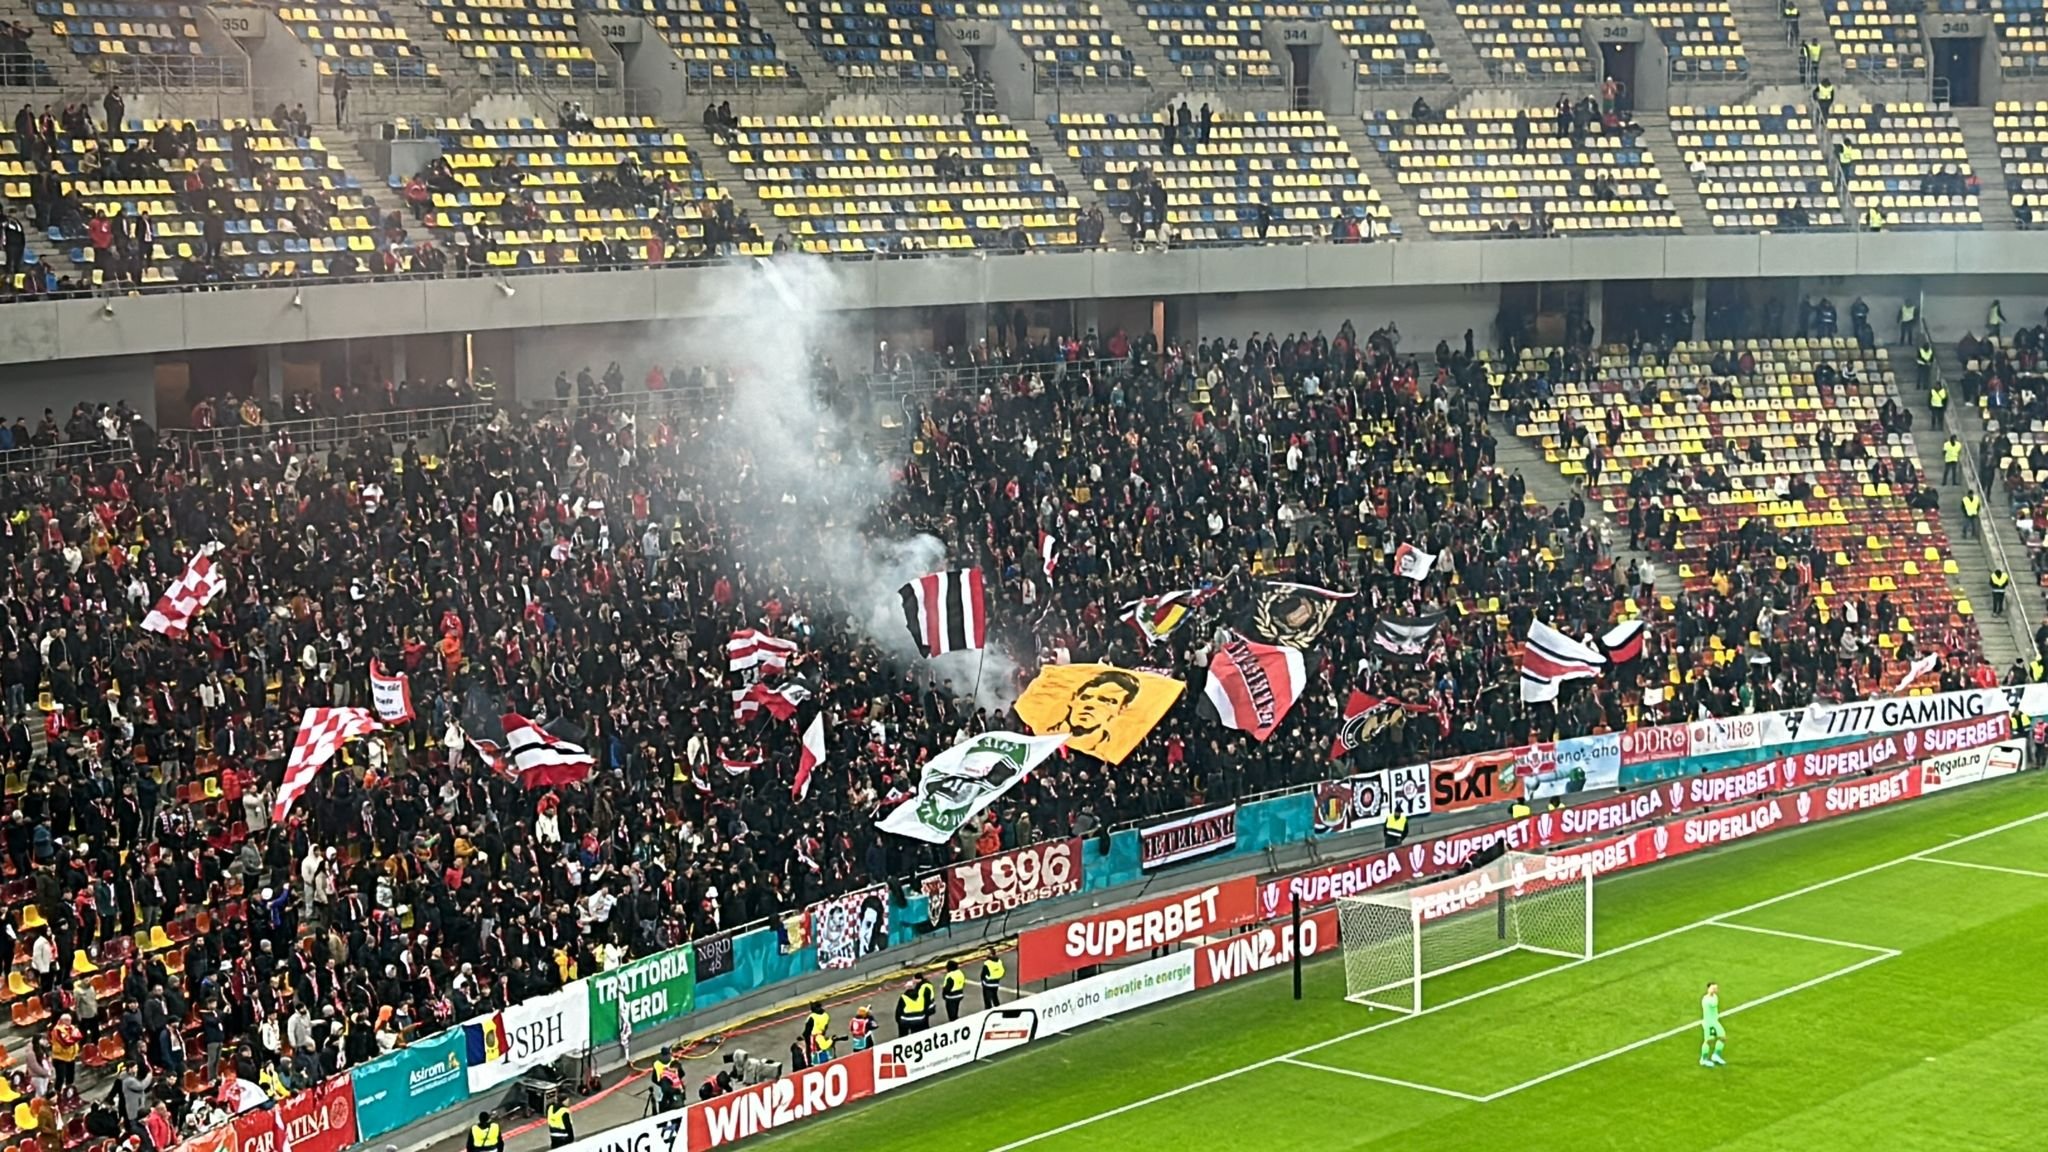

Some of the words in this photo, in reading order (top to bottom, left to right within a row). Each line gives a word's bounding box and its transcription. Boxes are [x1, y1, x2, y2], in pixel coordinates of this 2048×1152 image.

[222, 18, 249, 31] 350
[1827, 706, 1875, 734] 7777
[1882, 693, 1984, 727] GAMING
[1924, 714, 2008, 751] SUPERBET
[1804, 738, 1898, 777] SUPERLIGA
[1934, 754, 1980, 776] Regata.ro
[1690, 765, 1777, 802] SUPERBET
[1826, 769, 1910, 811] SUPERBET
[1560, 789, 1663, 833] SUPERLIGA
[1684, 801, 1783, 844] SUPERLIGA
[955, 844, 1071, 913] 1996
[1288, 851, 1402, 902] SUPERLIGA
[1545, 834, 1637, 881] SUPERBET
[1065, 886, 1220, 957] SUPERBET
[1207, 919, 1317, 984] WIN2.RO
[595, 951, 689, 1005] TRATTORIA
[1156, 964, 1192, 985] energie
[893, 1025, 971, 1064] Regata.ro
[409, 1061, 446, 1086] Asirom
[705, 1063, 848, 1147] WIN2.RO
[244, 1105, 330, 1152] CARATINA
